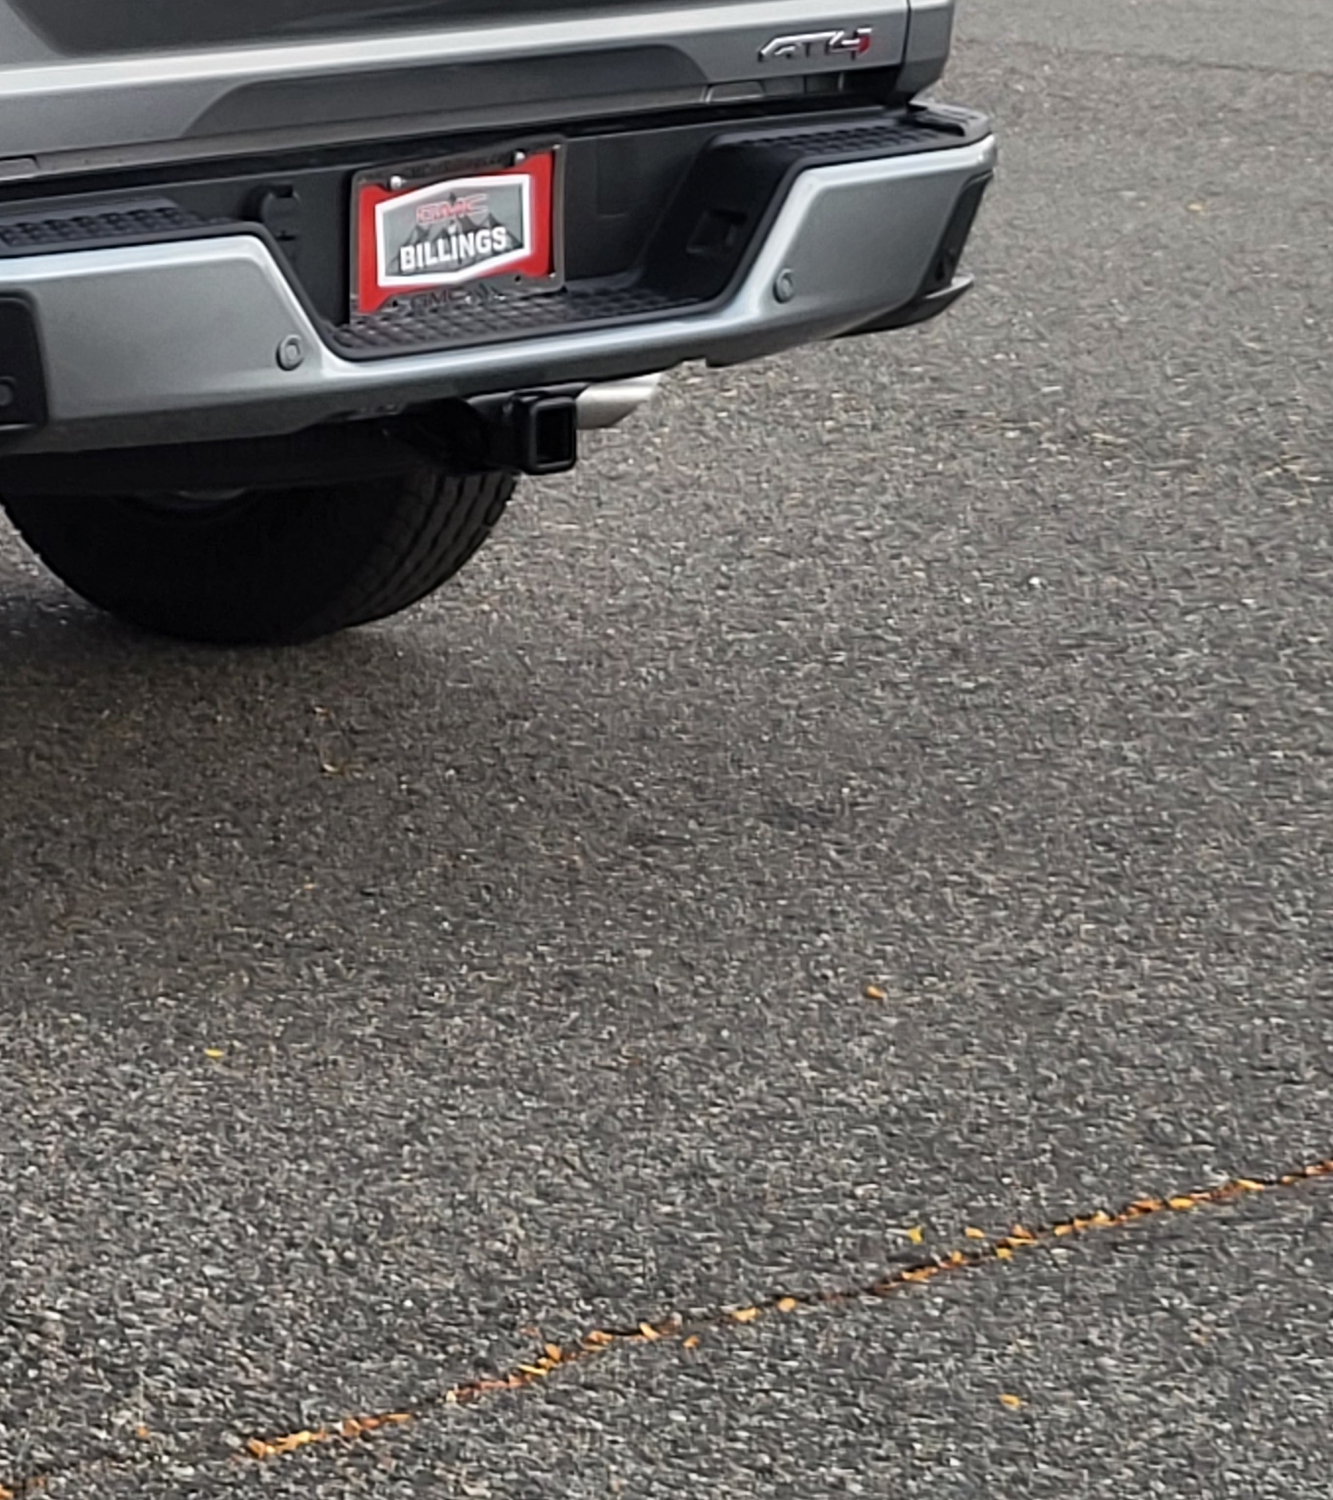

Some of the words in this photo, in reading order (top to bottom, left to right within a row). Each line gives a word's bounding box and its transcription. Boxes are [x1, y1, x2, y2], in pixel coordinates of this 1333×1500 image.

[757, 26, 873, 62] AT4
[416, 193, 488, 224] GMC
[399, 226, 507, 272] BILLINGS
